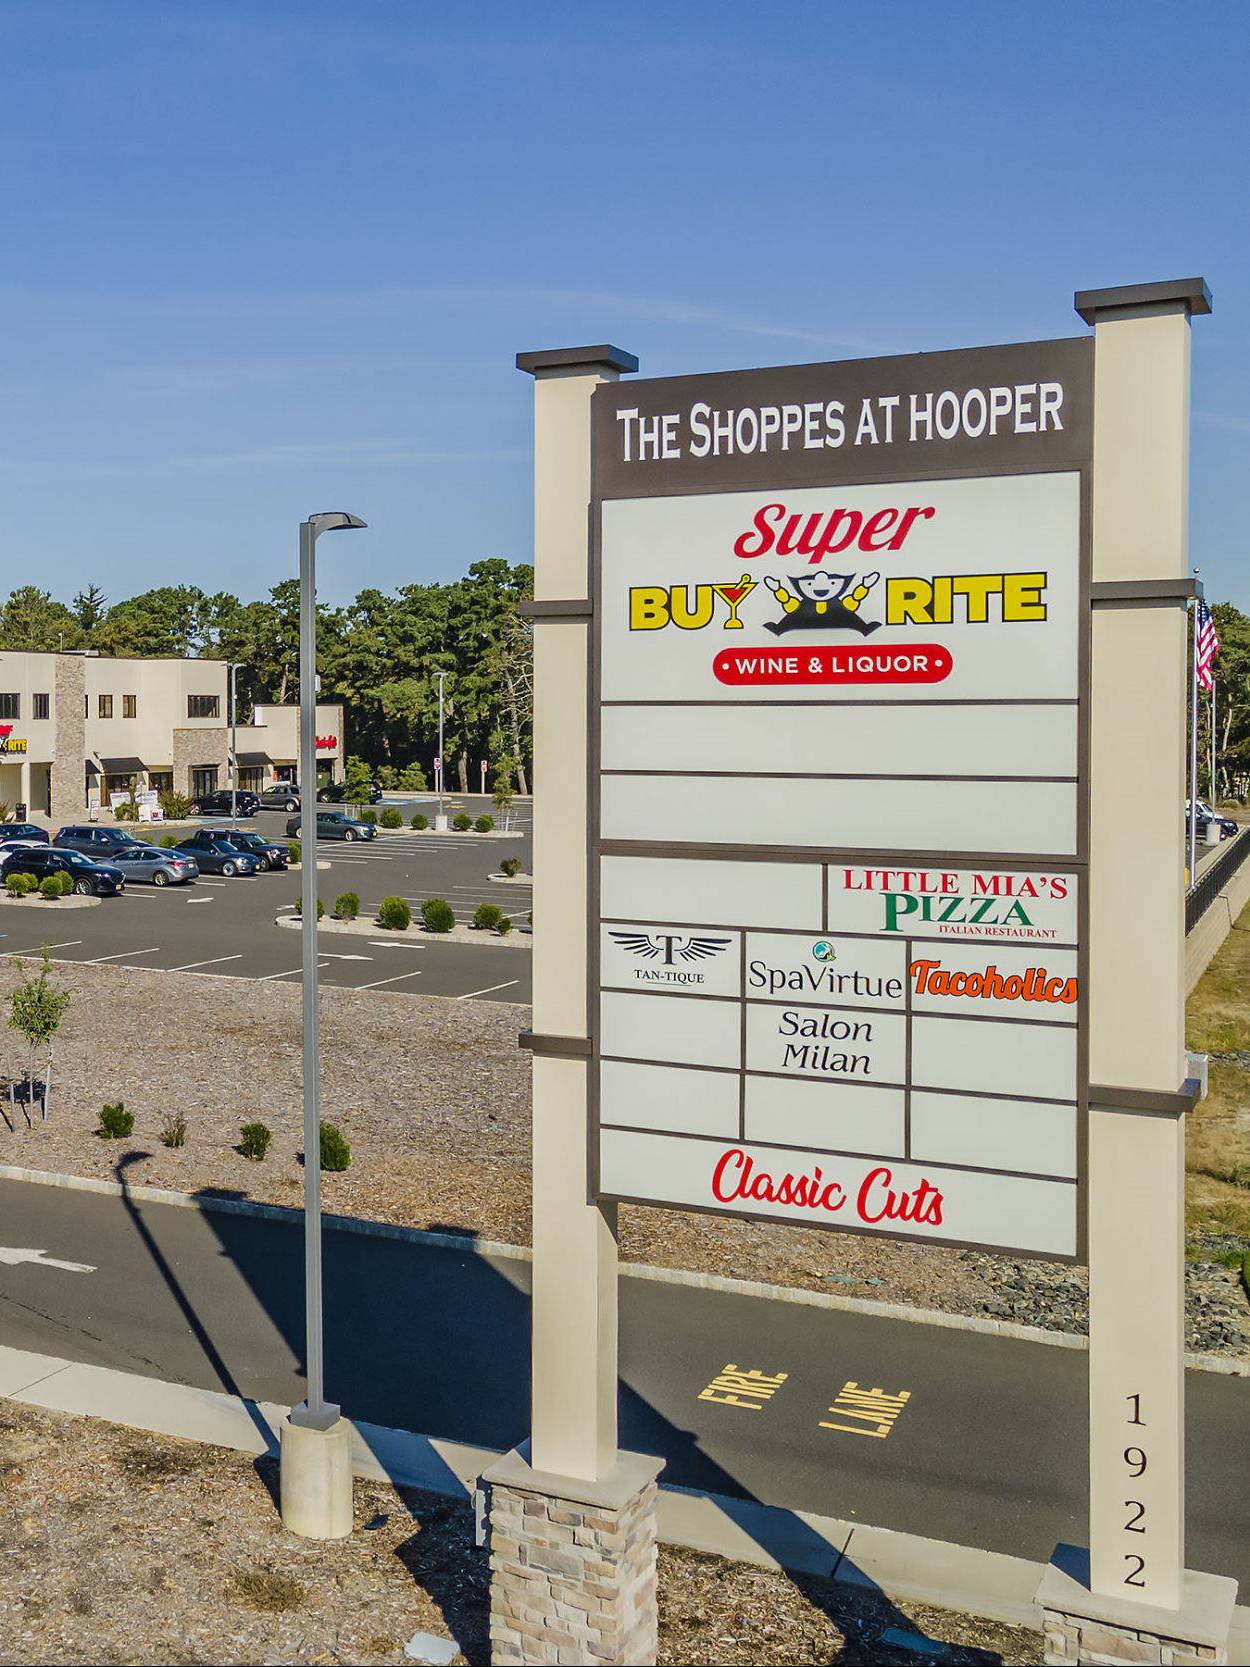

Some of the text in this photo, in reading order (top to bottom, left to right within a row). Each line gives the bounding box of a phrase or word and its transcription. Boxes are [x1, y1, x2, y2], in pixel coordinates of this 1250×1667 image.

[616, 382, 1065, 462] THE SHOPPES AT HOOPER
[733, 503, 936, 565] Super
[628, 571, 1048, 632] BUY RITE
[735, 655, 929, 675] WINE & LIQUOR
[7, 739, 28, 753] RITE
[842, 869, 1068, 899] LITTLE MIA'S
[879, 892, 1034, 932] PIZZA
[939, 924, 1057, 939] ITALIAN RESTAURANT
[634, 969, 705, 984] TAN-TIQUE
[749, 960, 903, 998] SpaVirtue
[909, 959, 1079, 1003] Tacoholics
[778, 1011, 873, 1042] Salon
[782, 1043, 870, 1074] Milan
[712, 1149, 944, 1226] Classic Cuts
[697, 1363, 911, 1439] FIRE LANE
[1123, 1393, 1147, 1588] 1922
